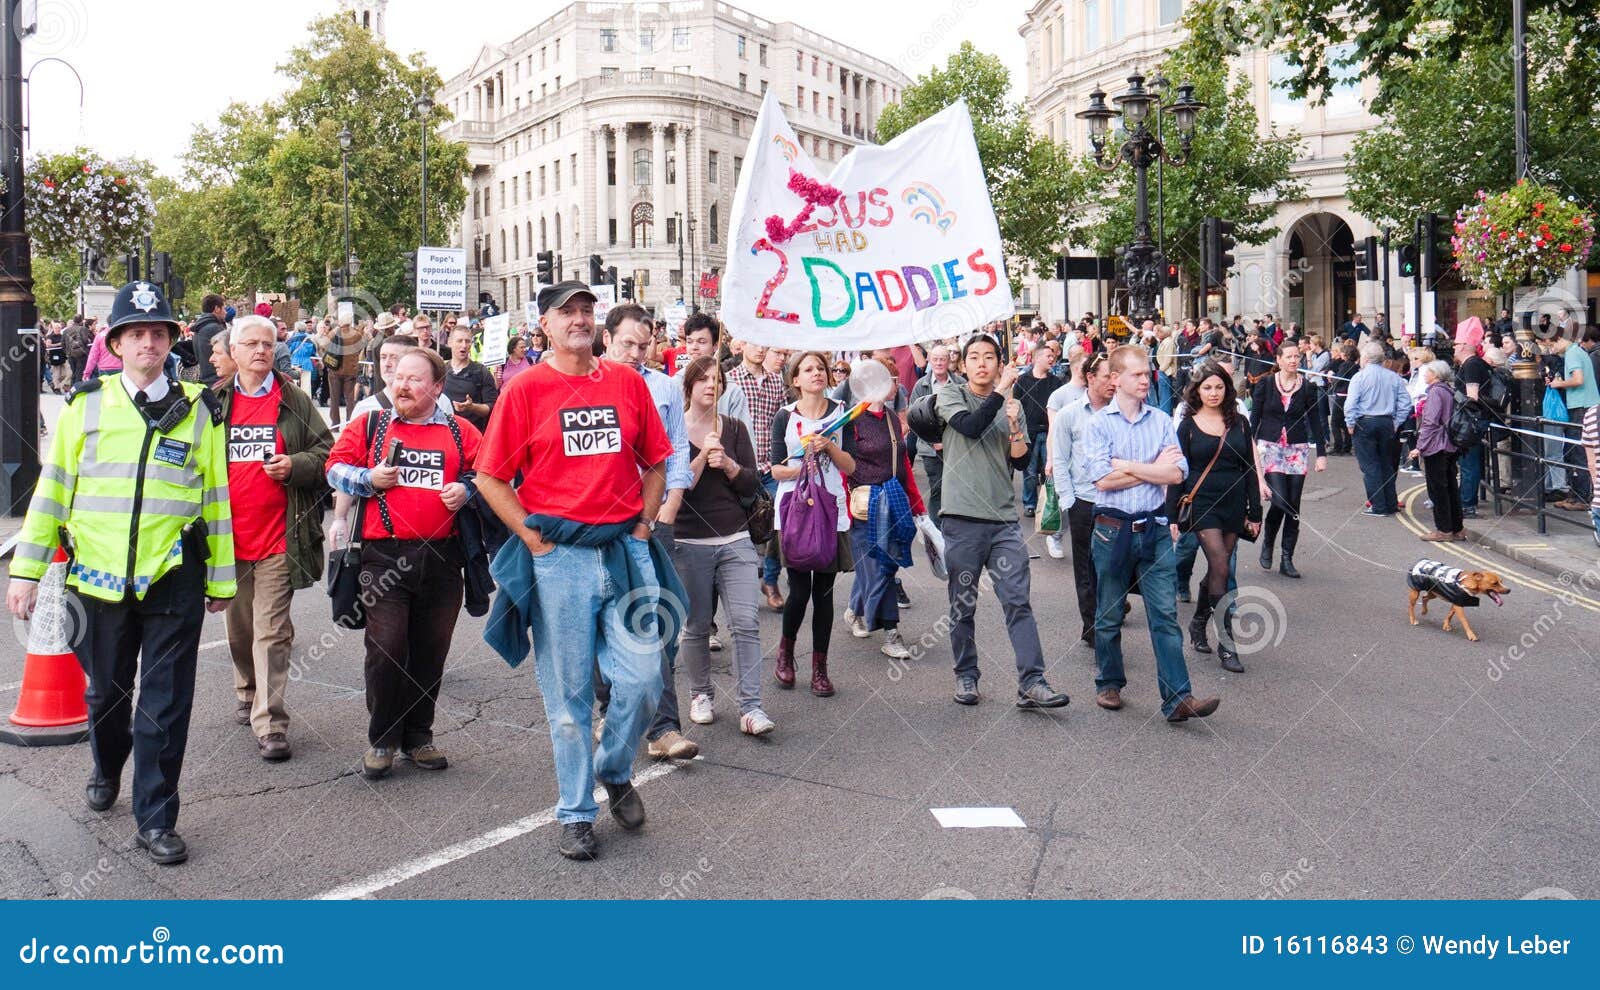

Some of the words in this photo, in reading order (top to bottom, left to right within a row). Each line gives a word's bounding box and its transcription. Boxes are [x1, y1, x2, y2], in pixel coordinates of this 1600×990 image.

[814, 230, 868, 252] HAD
[430, 255, 454, 263] Pope's
[422, 267, 462, 275] opposition
[750, 238, 800, 325] 2
[801, 248, 997, 328] DADDIES
[420, 289, 436, 297] kills
[438, 290, 463, 299] people
[563, 408, 616, 428] POPE
[230, 427, 273, 440] POPE
[568, 431, 619, 453] NOPE
